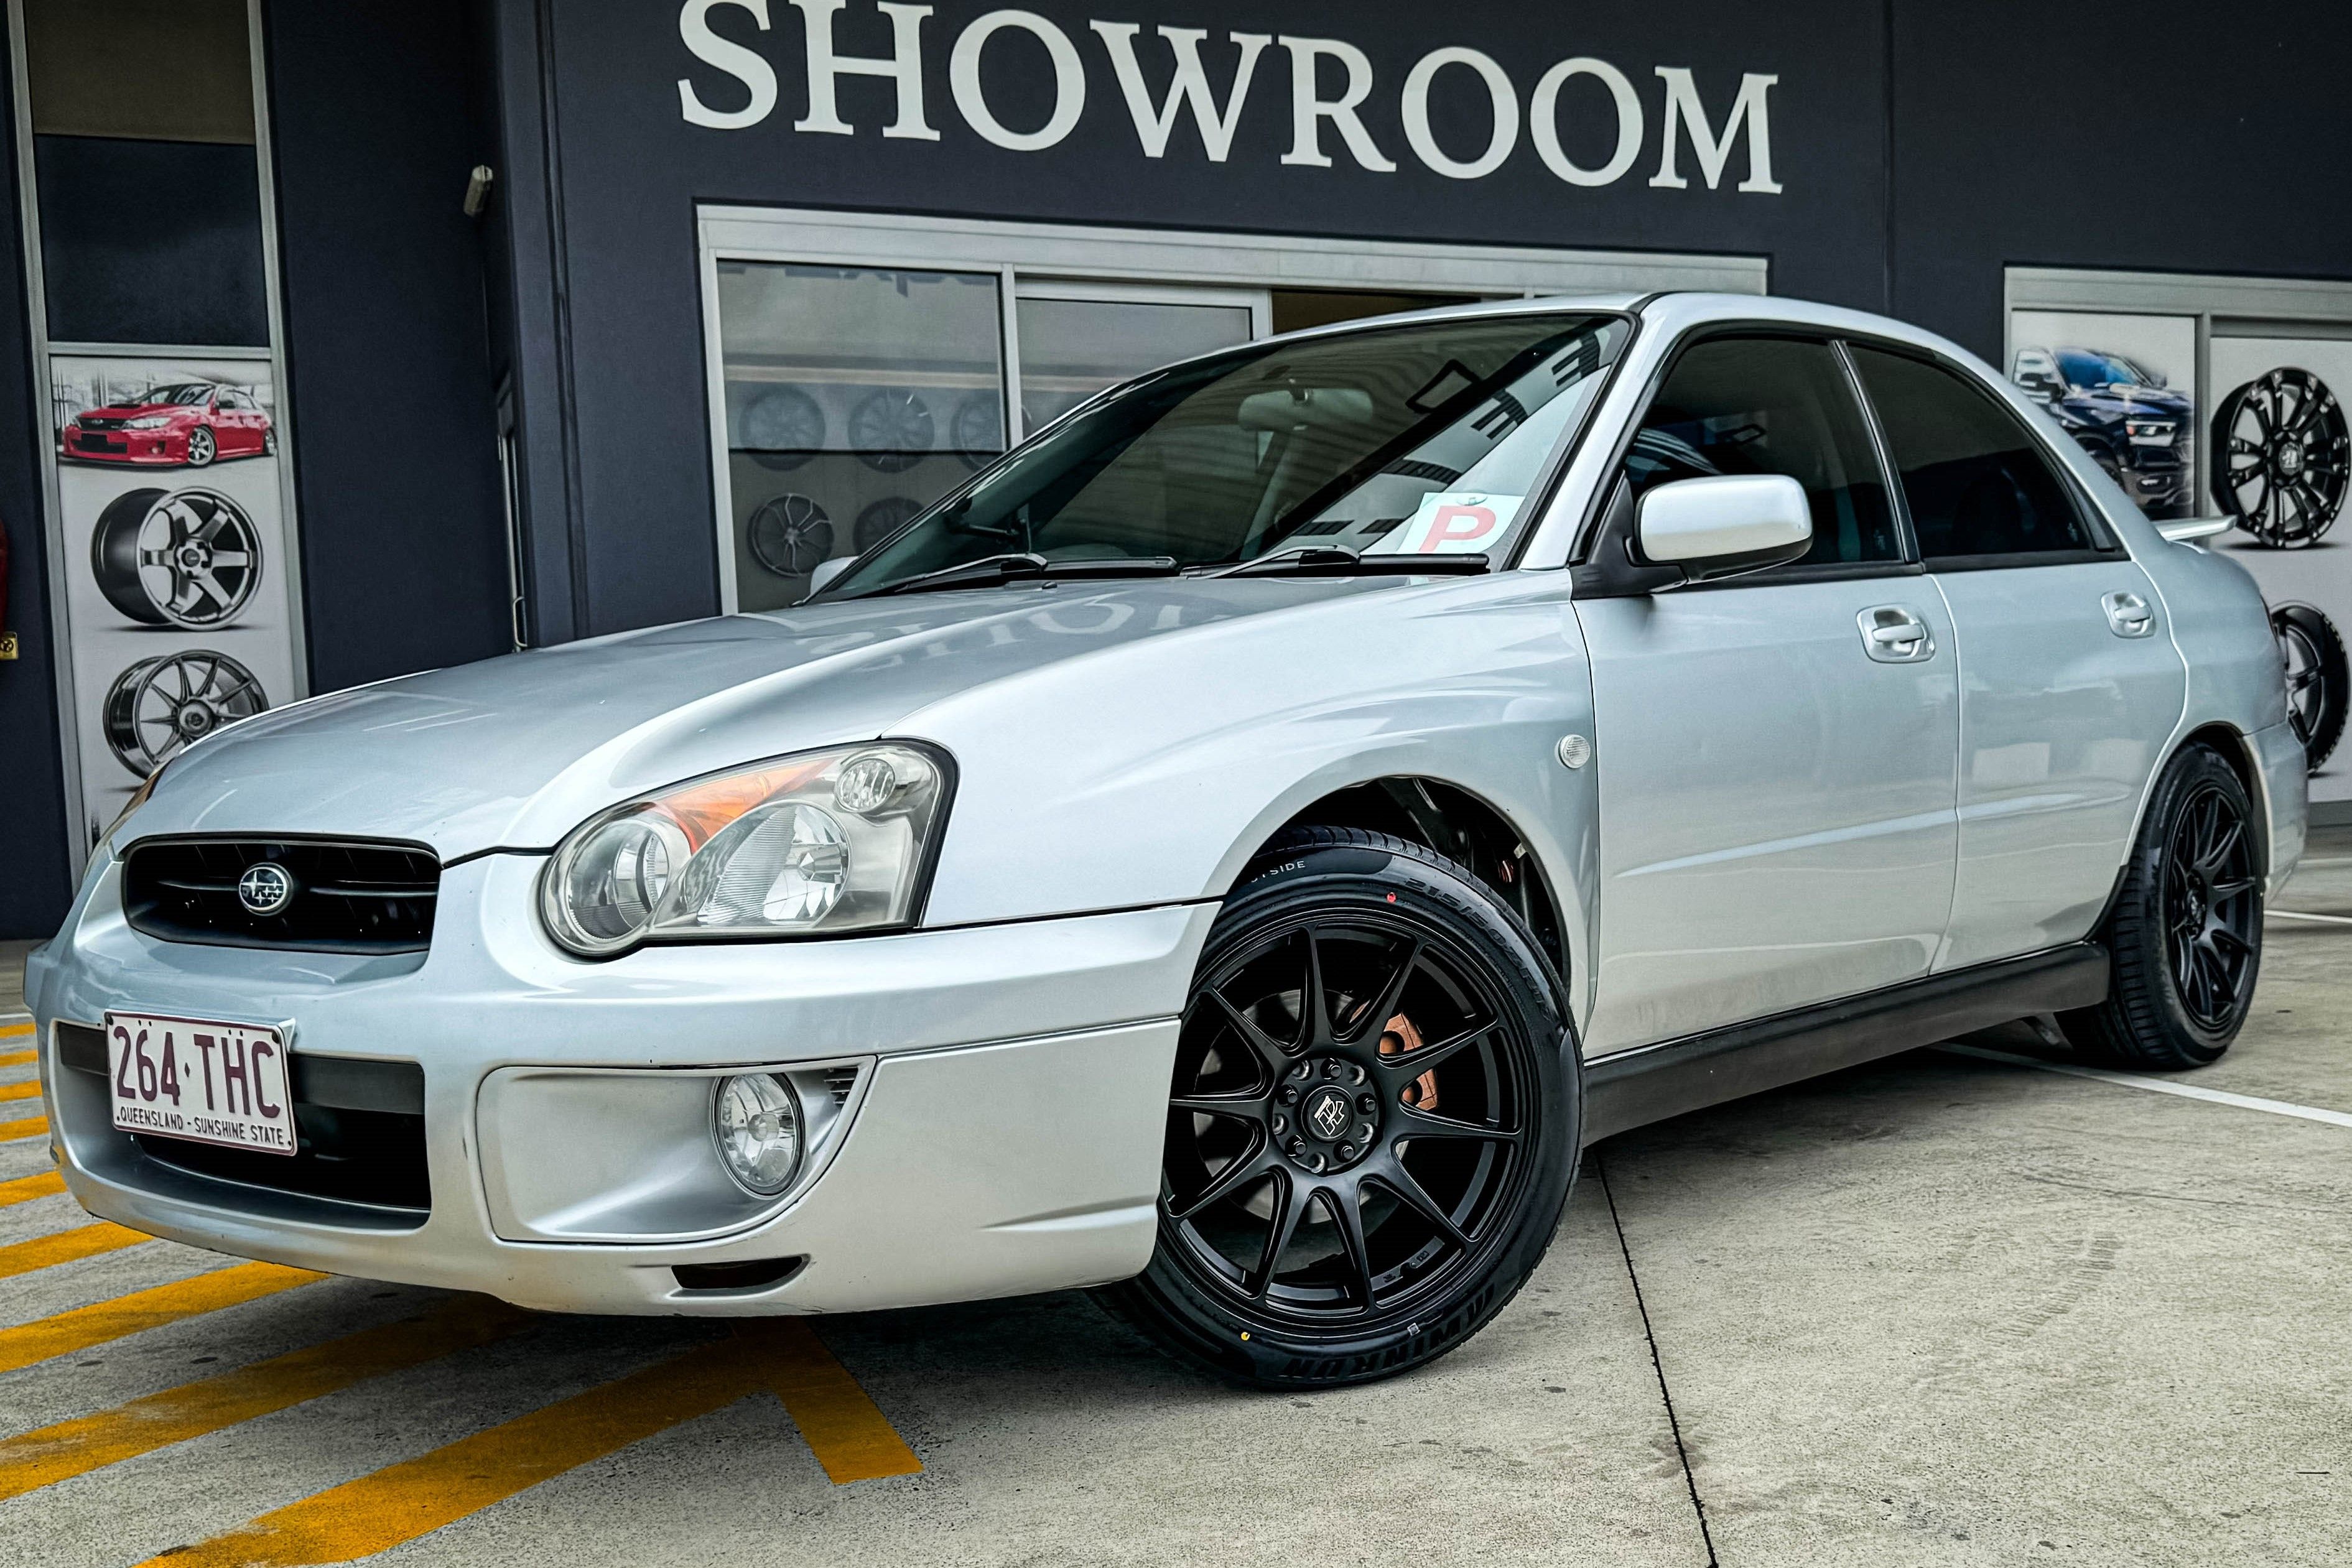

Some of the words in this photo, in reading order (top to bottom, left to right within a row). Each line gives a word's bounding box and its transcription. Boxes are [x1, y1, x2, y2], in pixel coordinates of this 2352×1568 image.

[678, 0, 1783, 194] SHOWROOM
[1419, 506, 1496, 554] P
[120, 1106, 184, 1130] QUEENSLAND
[195, 1117, 245, 1140] SUNSHINE
[250, 1125, 284, 1145] STATE
